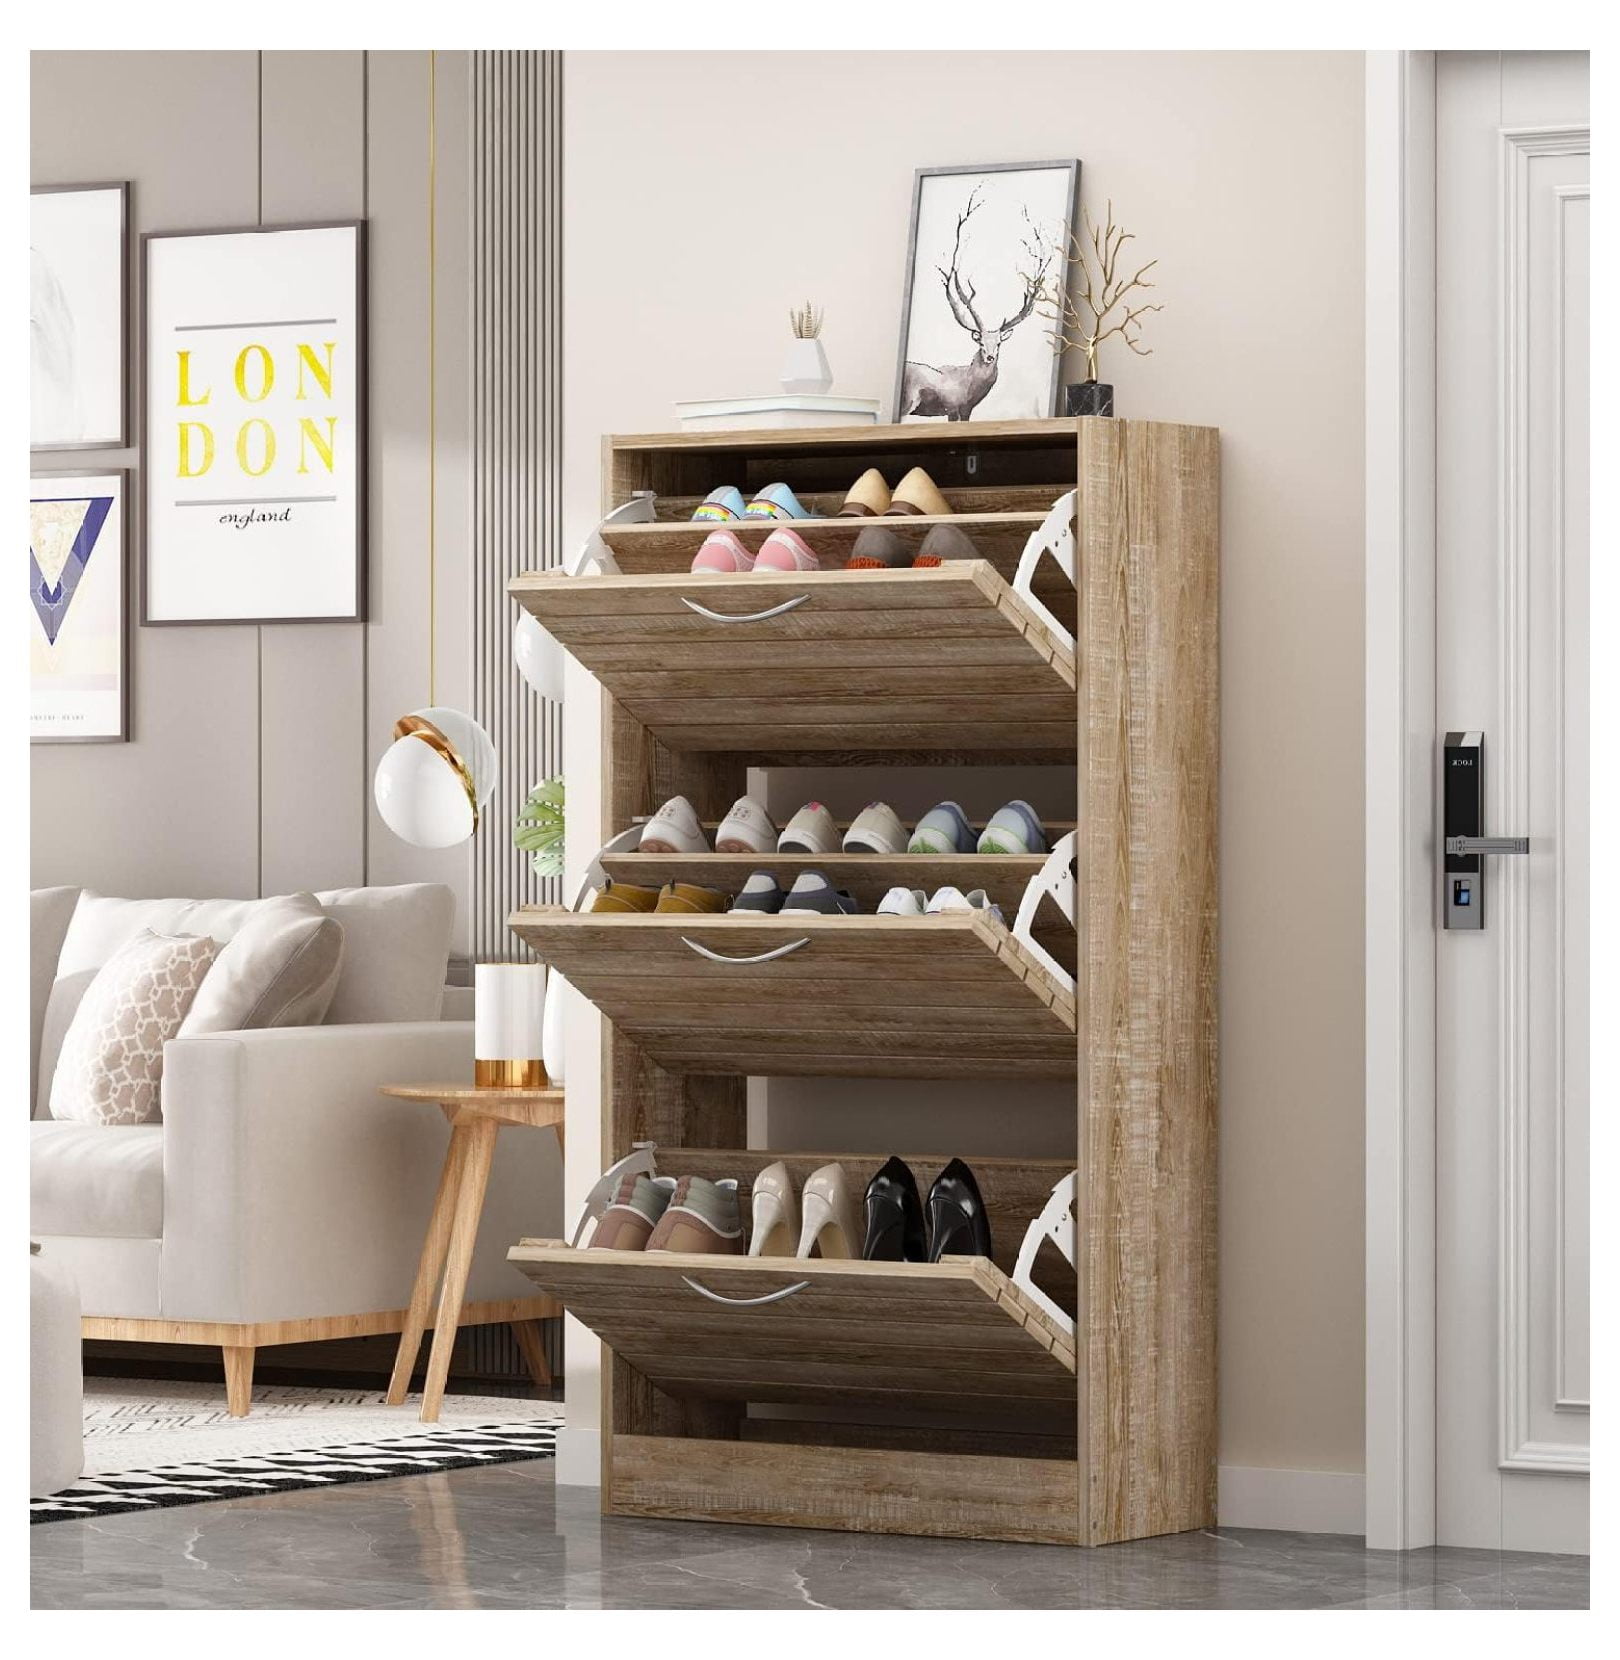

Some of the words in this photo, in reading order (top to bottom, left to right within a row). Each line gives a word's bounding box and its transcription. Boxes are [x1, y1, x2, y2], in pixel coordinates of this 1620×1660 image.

[176, 342, 337, 406] LON
[176, 416, 338, 478] DON
[219, 507, 292, 529] england
